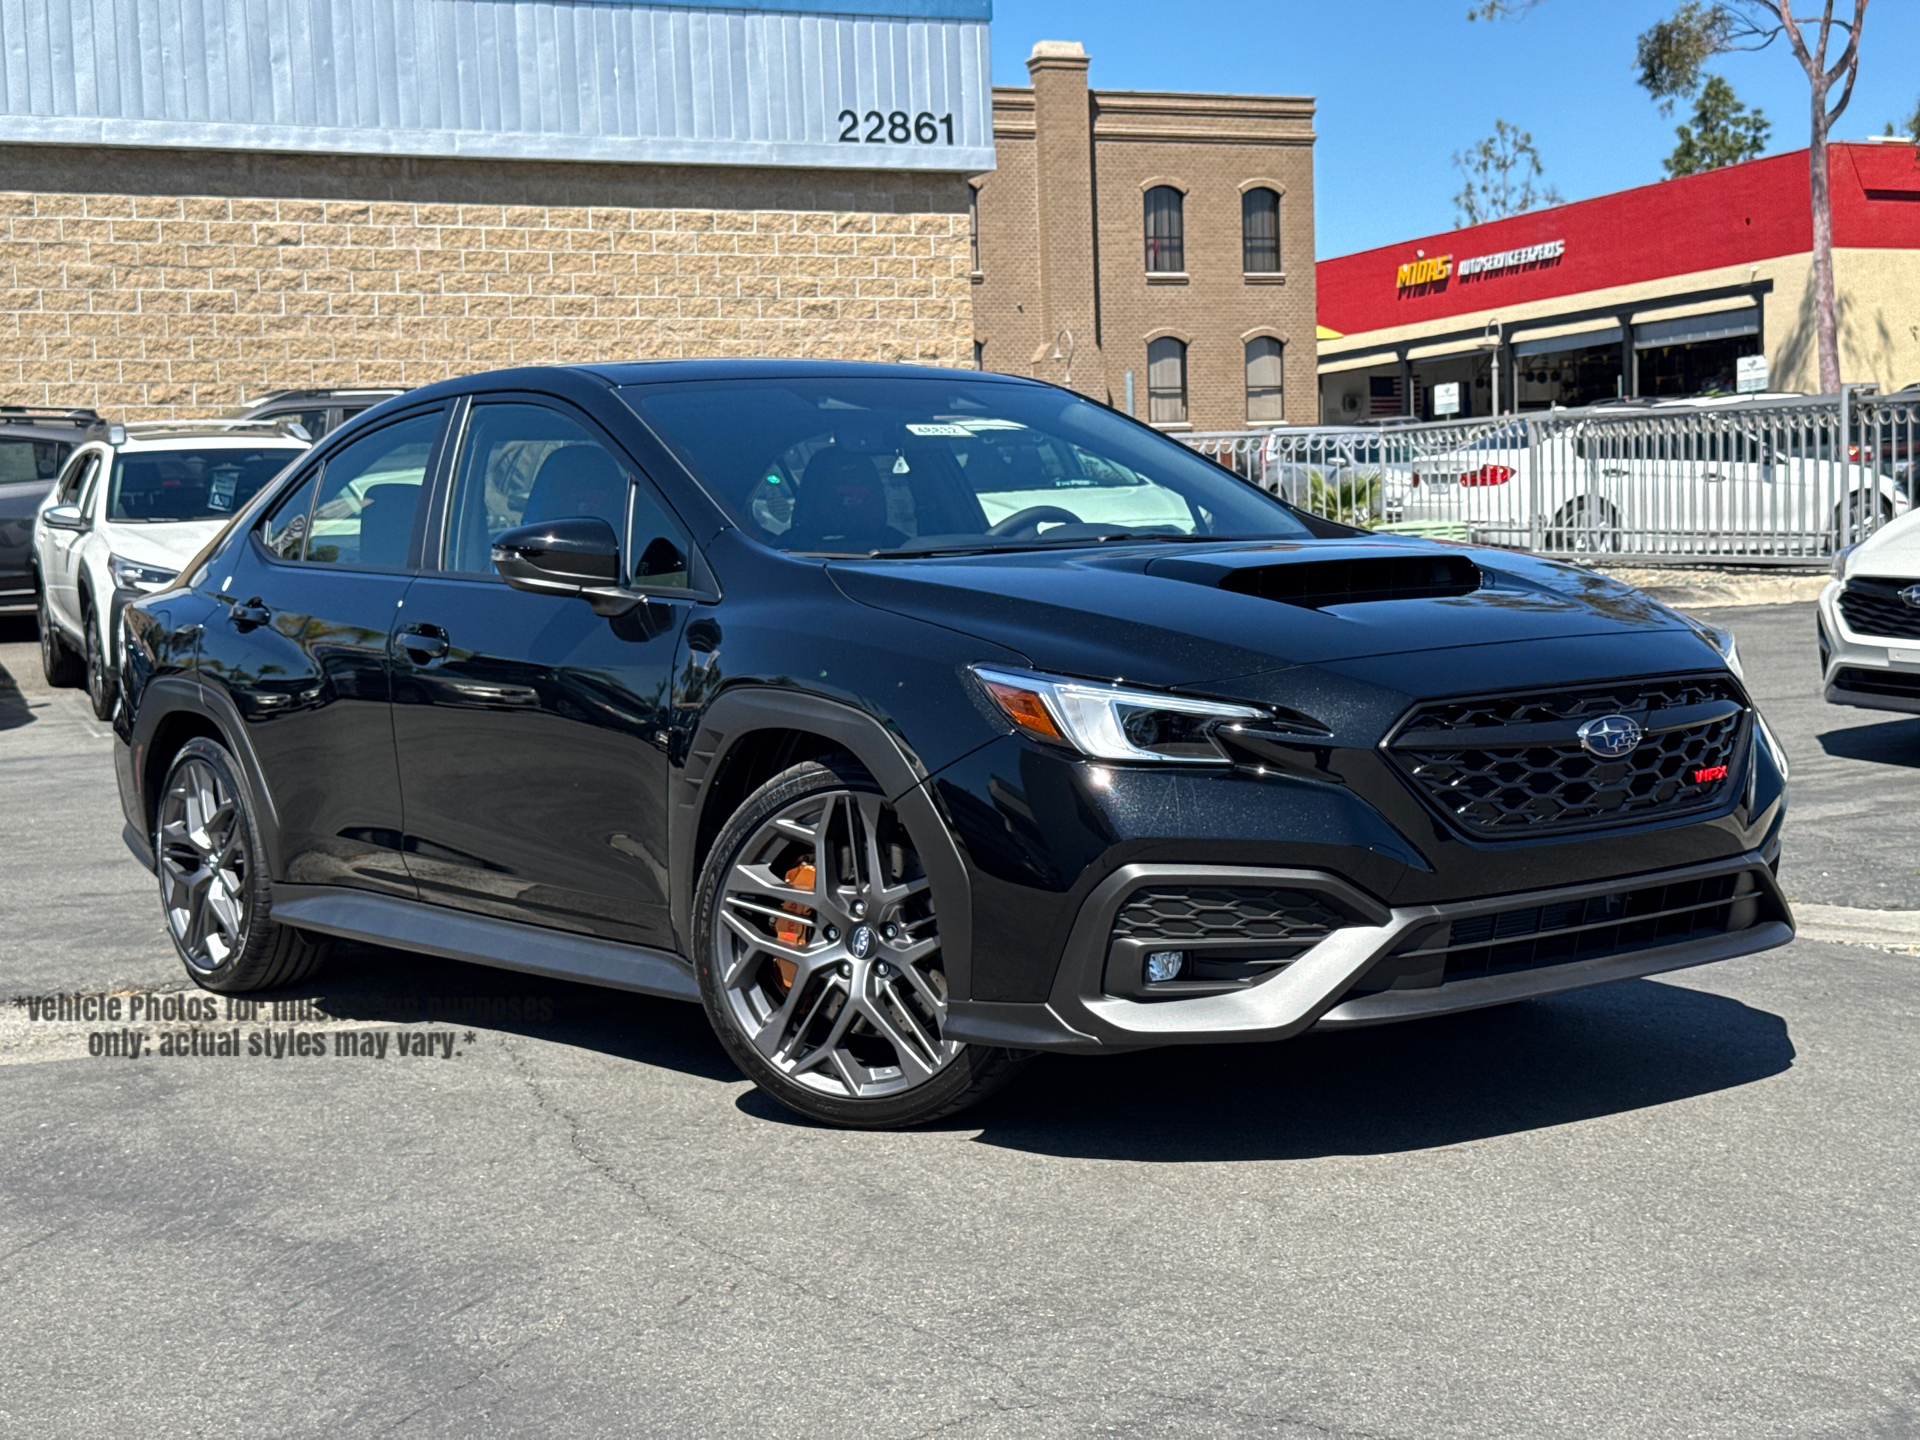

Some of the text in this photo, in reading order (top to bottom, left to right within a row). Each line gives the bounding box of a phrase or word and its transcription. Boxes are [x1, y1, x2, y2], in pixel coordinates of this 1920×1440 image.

[838, 109, 954, 145] 22861
[1396, 254, 1453, 288] MIDAS
[1694, 765, 1728, 783] WRX
